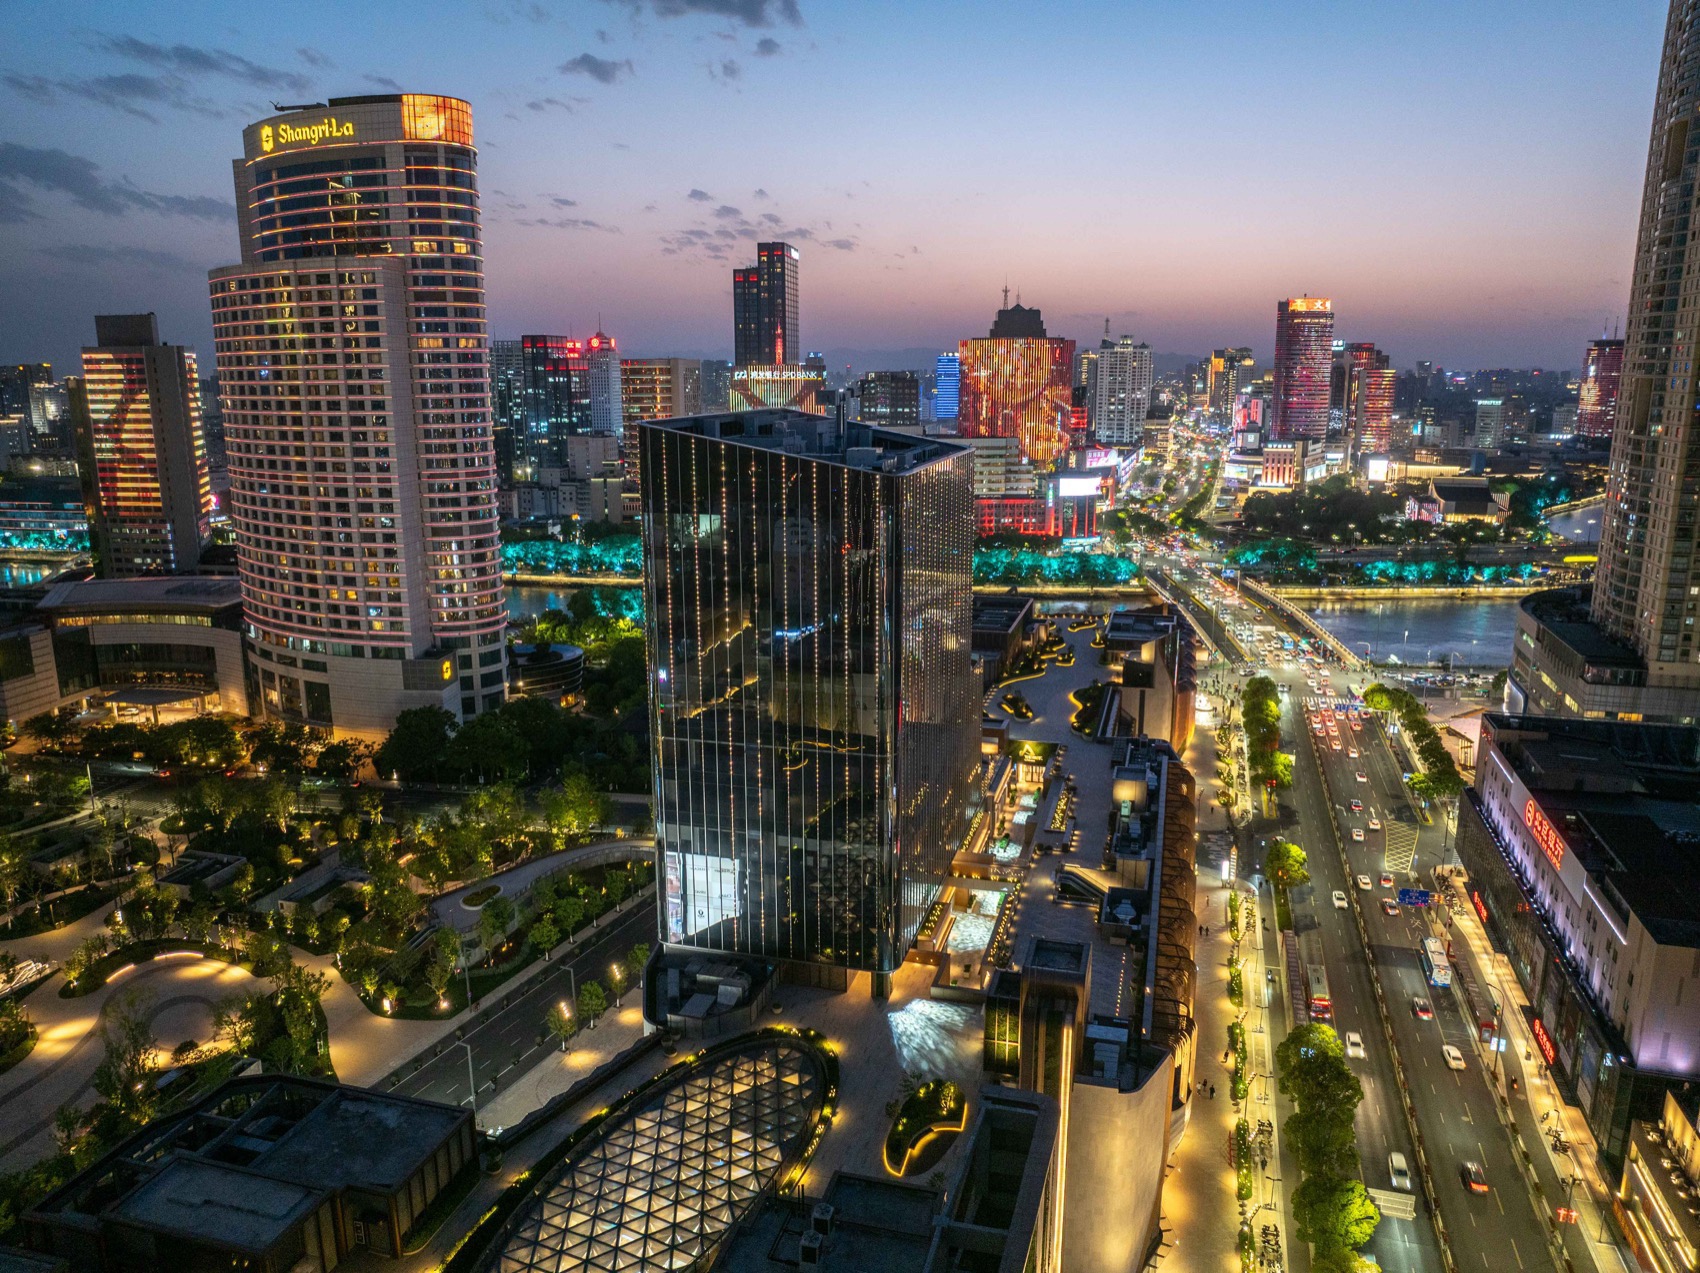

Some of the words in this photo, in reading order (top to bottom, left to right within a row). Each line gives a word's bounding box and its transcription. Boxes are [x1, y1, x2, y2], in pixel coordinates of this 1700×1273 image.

[782, 371, 797, 379] SPD
[797, 371, 817, 379] BANK
[1534, 811, 1564, 862] 北京银行
